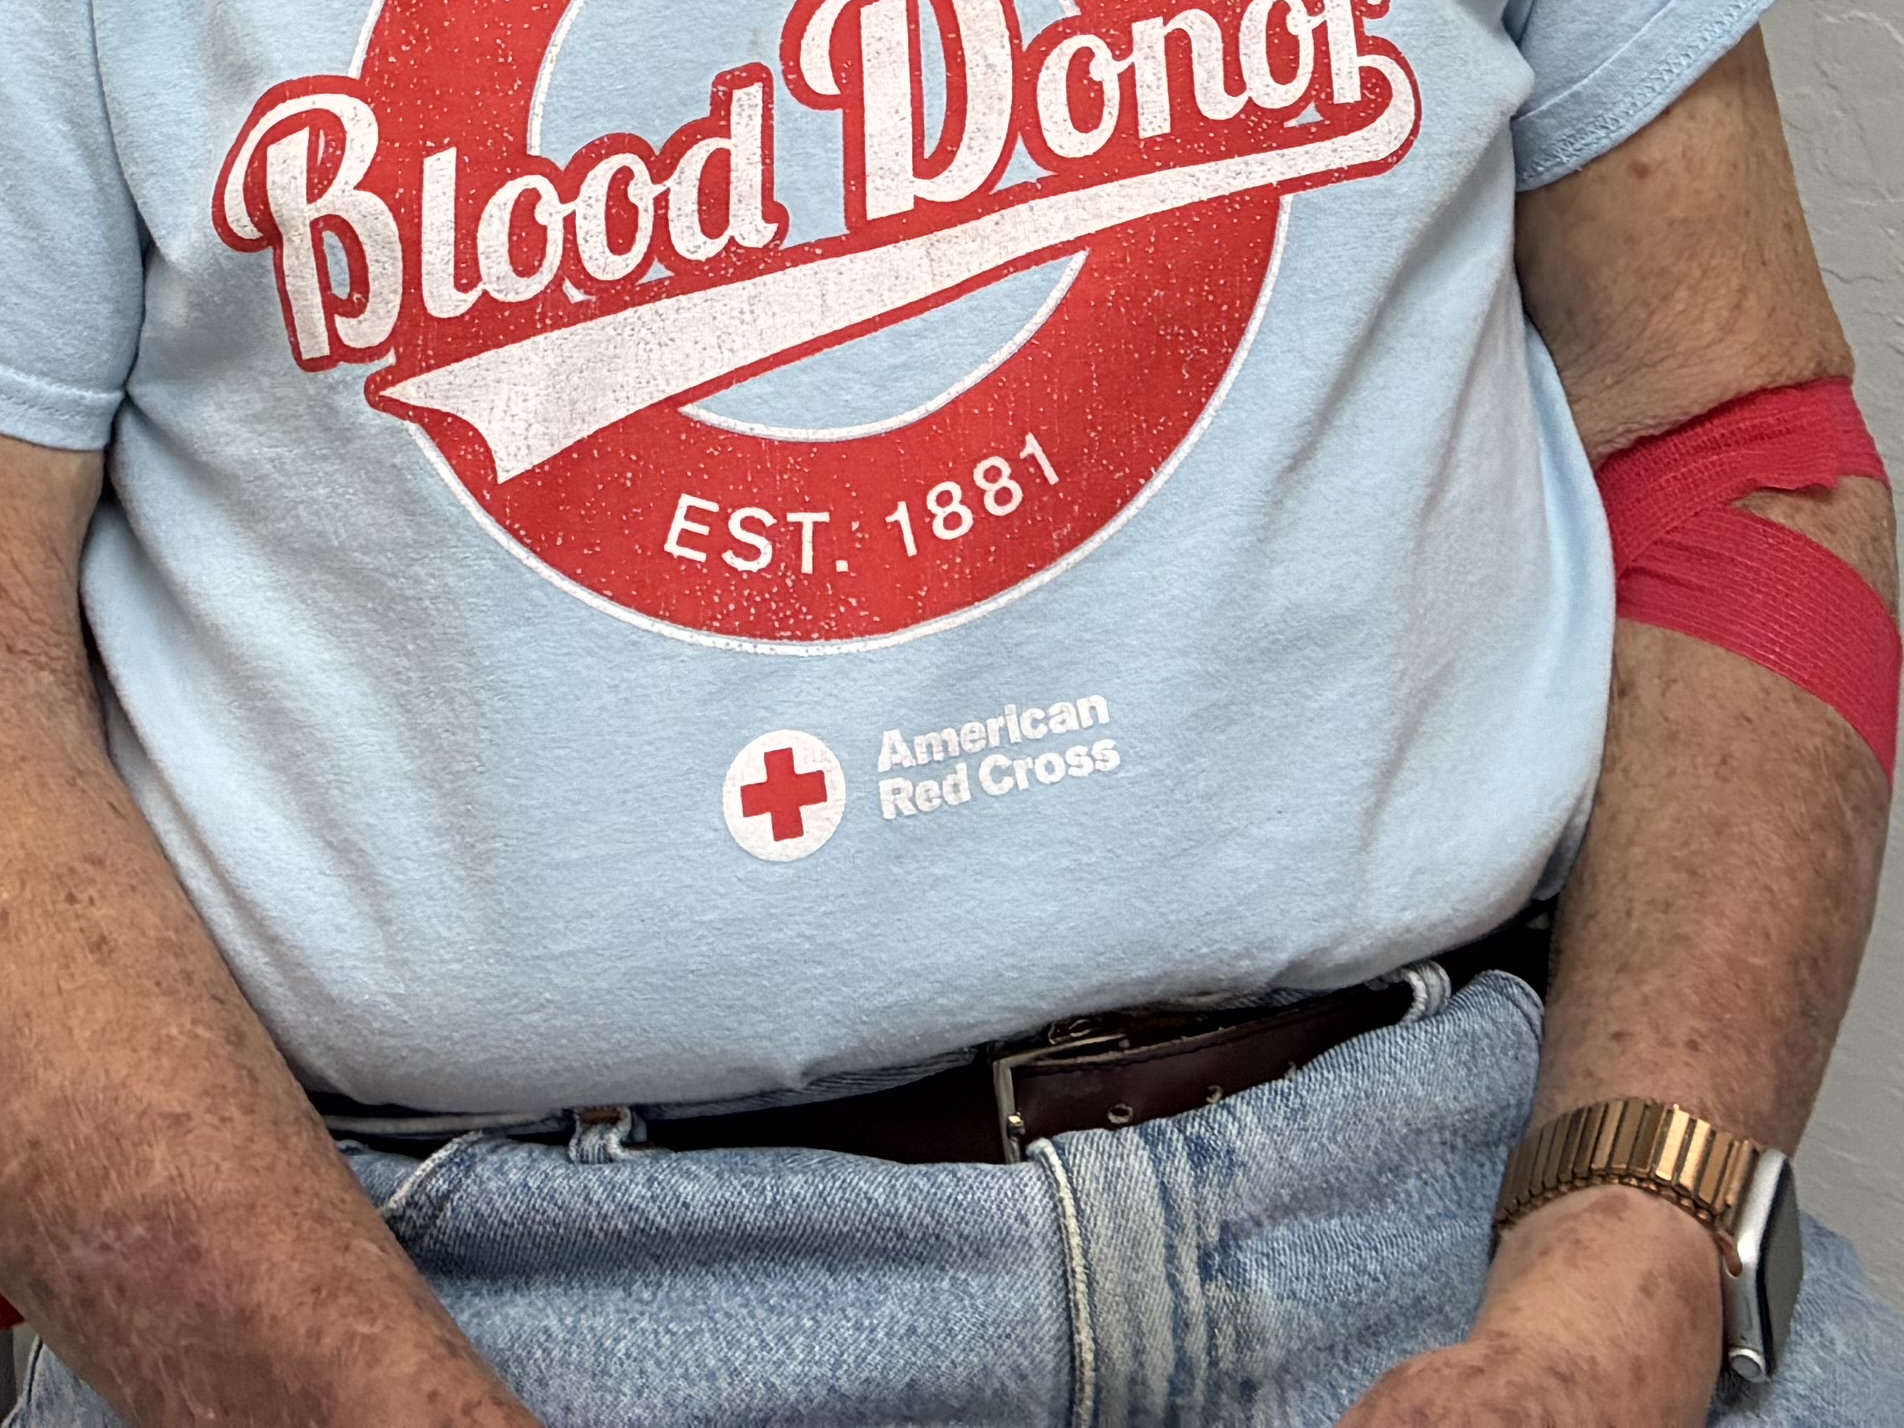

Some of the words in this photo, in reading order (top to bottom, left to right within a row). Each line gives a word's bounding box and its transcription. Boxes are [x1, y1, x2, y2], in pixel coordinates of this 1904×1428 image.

[223, 82, 782, 362] Blood
[662, 492, 852, 576] EST.
[885, 430, 1062, 558] 1881
[876, 693, 1111, 773] American
[878, 762, 971, 820] Red
[978, 737, 1122, 797] Cross
